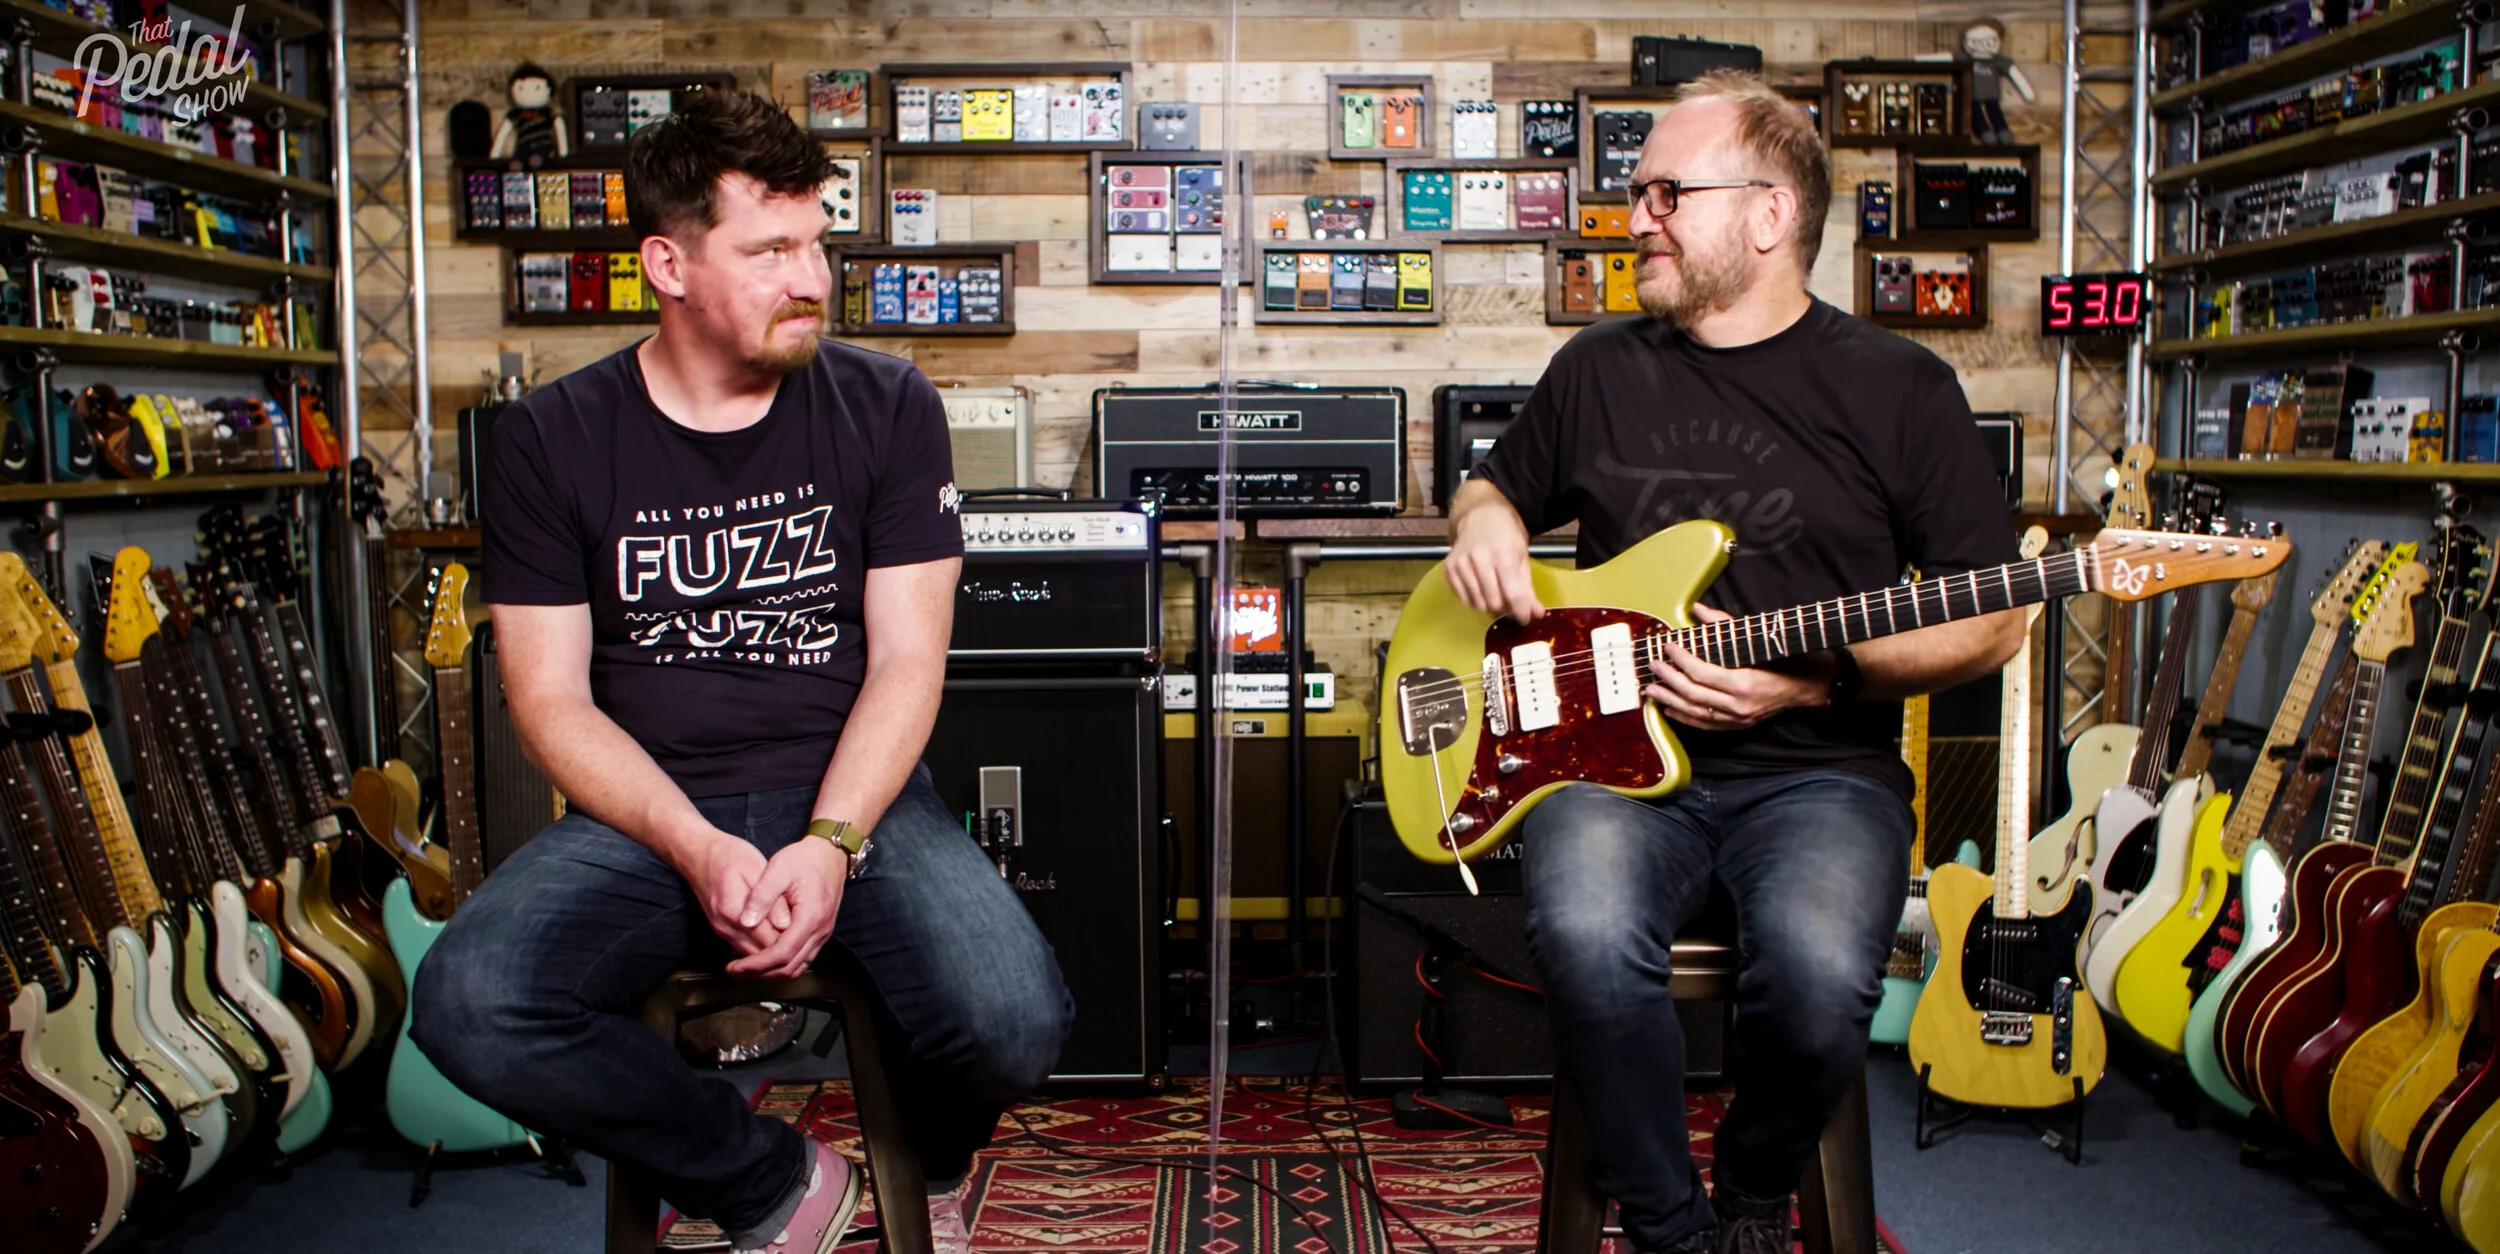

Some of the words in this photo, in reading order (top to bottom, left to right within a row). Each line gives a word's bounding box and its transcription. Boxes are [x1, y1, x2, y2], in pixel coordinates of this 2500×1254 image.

[2049, 281, 2142, 327] 53.0
[1651, 419, 1780, 464] BECAUSE
[635, 509, 671, 523] ALL
[683, 505, 724, 520] YOU
[735, 492, 786, 512] NEED
[798, 483, 815, 499] IS
[617, 505, 837, 601] FUZZ
[655, 653, 674, 664] IS
[685, 651, 721, 660] ALL
[734, 651, 775, 664] YOU
[788, 651, 832, 666] NEED
